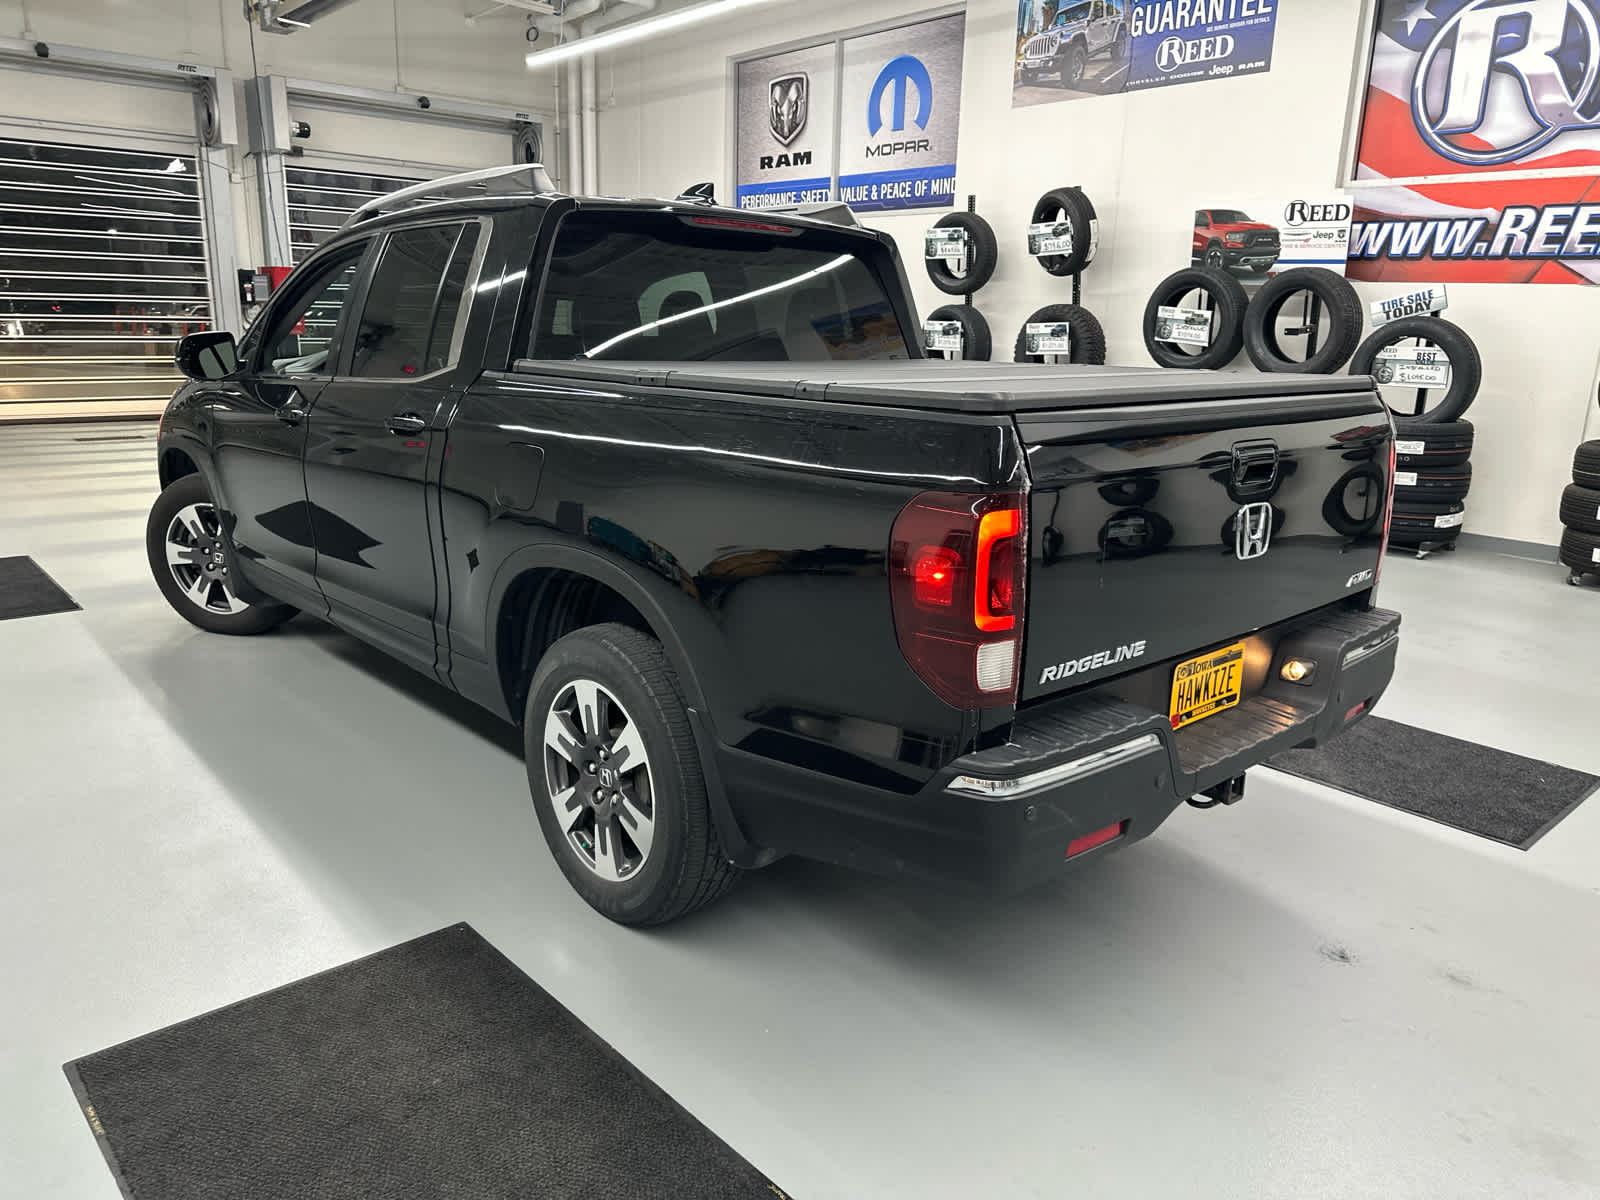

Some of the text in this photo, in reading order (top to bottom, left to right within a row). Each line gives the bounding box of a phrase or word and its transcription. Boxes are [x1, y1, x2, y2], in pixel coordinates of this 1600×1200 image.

[1157, 35, 1234, 71] REED
[1170, 70, 1204, 79] DODGE
[1209, 64, 1233, 75] Jeep
[1239, 61, 1265, 70] RAM
[865, 139, 930, 158] MOPAR
[760, 151, 812, 169] RAM
[840, 185, 869, 202] VALUE
[871, 184, 878, 200] &
[881, 181, 912, 199] PEACE
[915, 180, 928, 196] OF
[1286, 201, 1350, 224] REED
[1312, 230, 1334, 240] Jeep
[1380, 289, 1434, 312] TIRE SALE
[1383, 299, 1433, 320] TODAY
[1416, 352, 1437, 361] BEST
[1039, 640, 1146, 685] RIDGELINE
[1176, 663, 1237, 713] HAWKIZE
